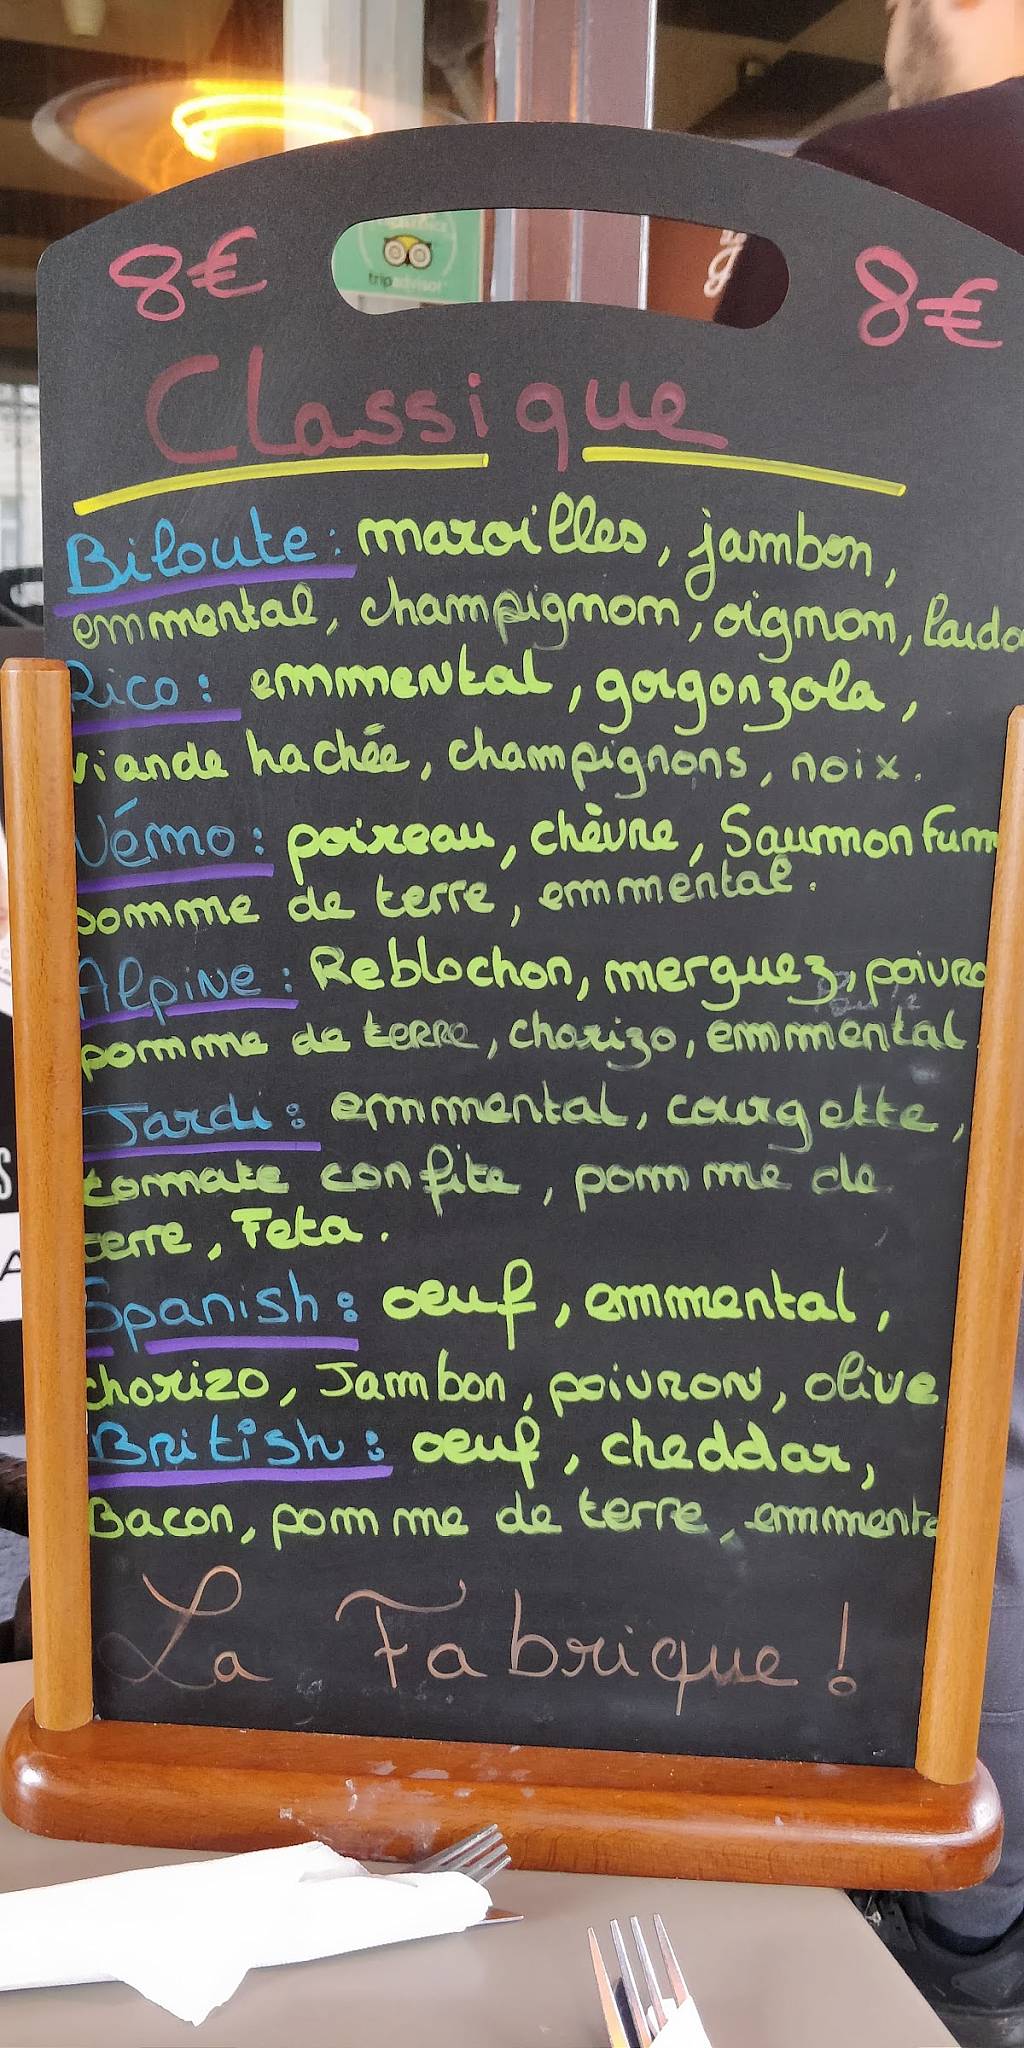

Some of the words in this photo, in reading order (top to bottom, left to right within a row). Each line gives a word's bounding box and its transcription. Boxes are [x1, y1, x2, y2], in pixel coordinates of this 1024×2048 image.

[146, 346, 728, 472] Classique
[288, 887, 355, 922] de
[292, 1025, 351, 1055] de
[813, 1152, 893, 1194] de
[496, 1496, 562, 1535] de
[101, 1564, 273, 1691] La
[334, 1578, 800, 1716] Fabrique
